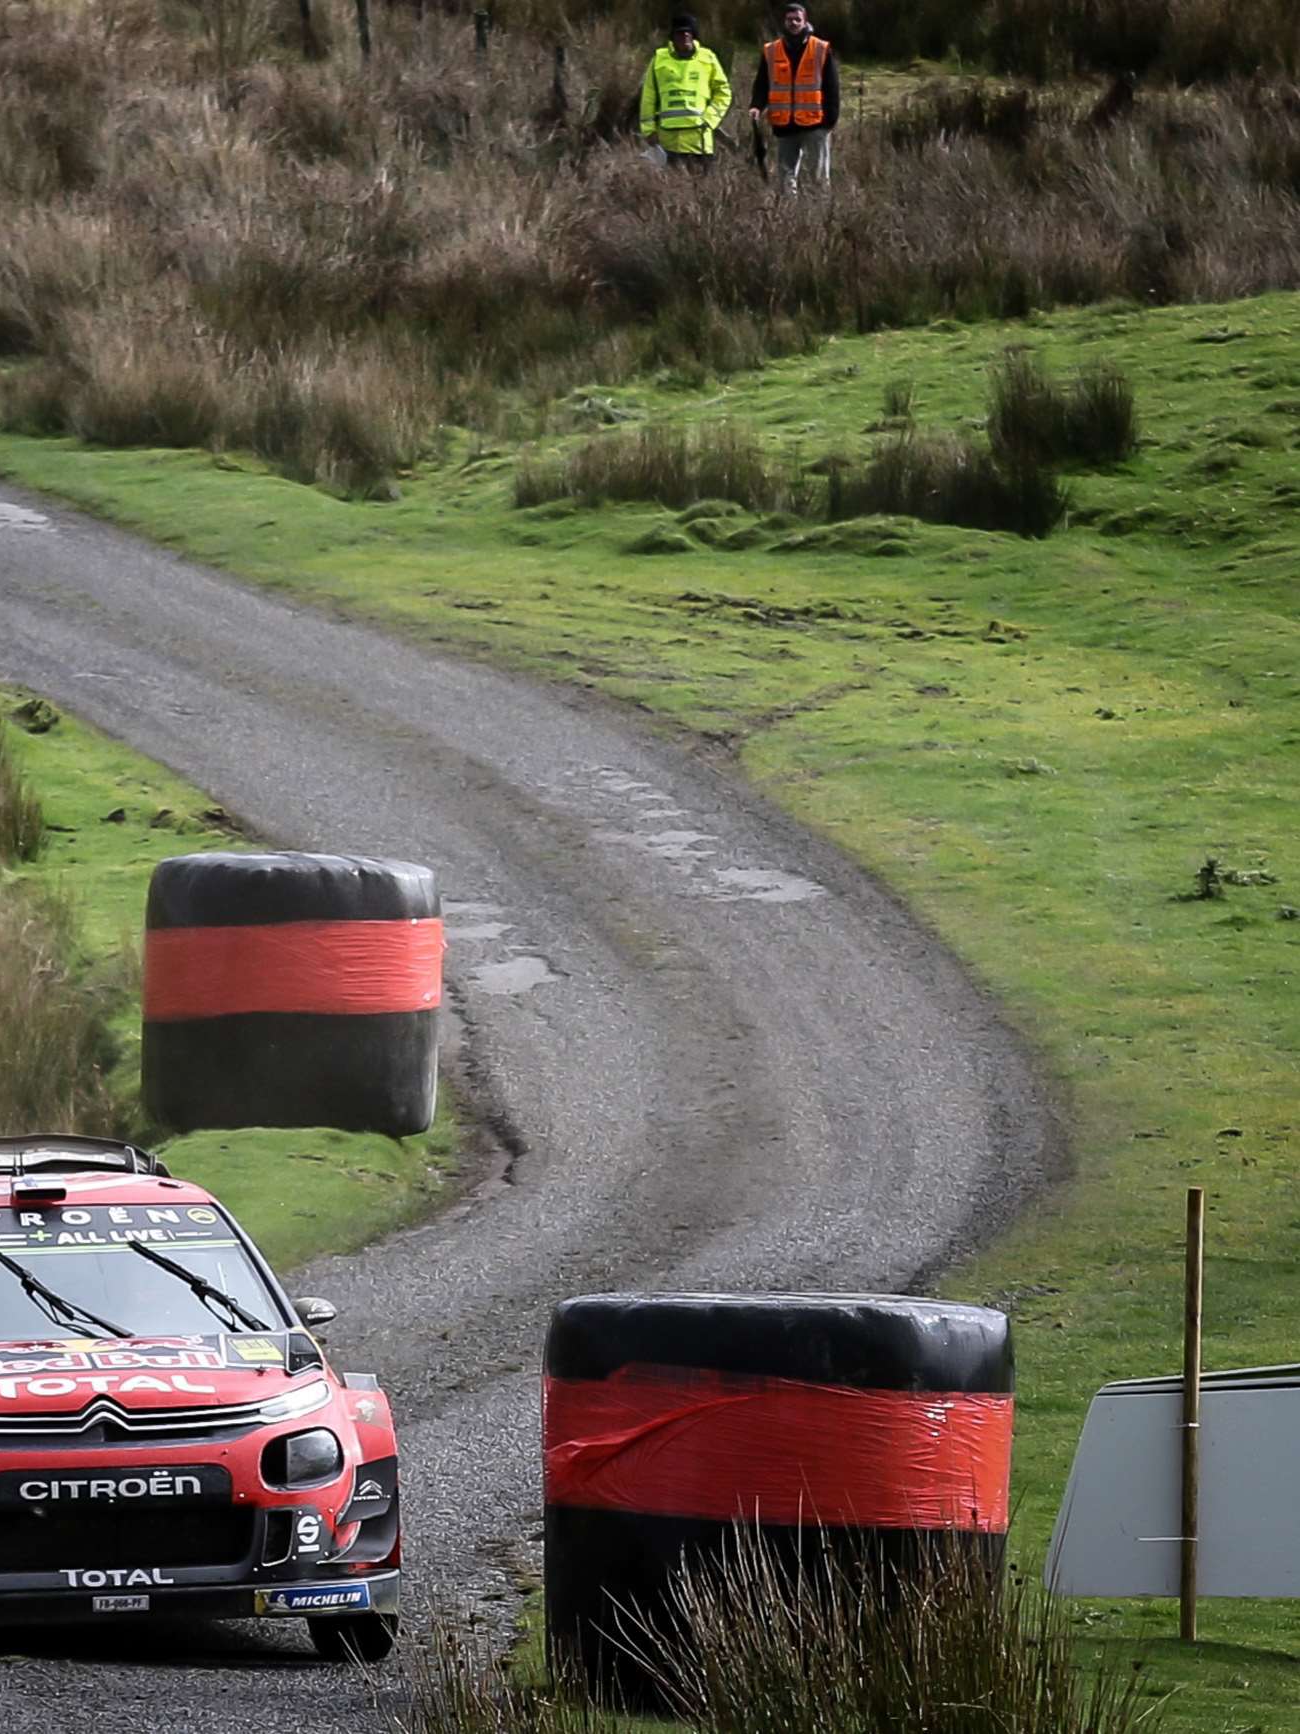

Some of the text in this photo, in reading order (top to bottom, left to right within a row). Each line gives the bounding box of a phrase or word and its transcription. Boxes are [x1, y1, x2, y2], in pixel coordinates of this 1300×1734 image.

[58, 1231, 106, 1244] ALL
[110, 1229, 169, 1242] LIVE
[93, 1350, 226, 1370] Bull
[59, 1568, 174, 1587] TOTAL
[291, 1592, 361, 1607] MICHELIN
